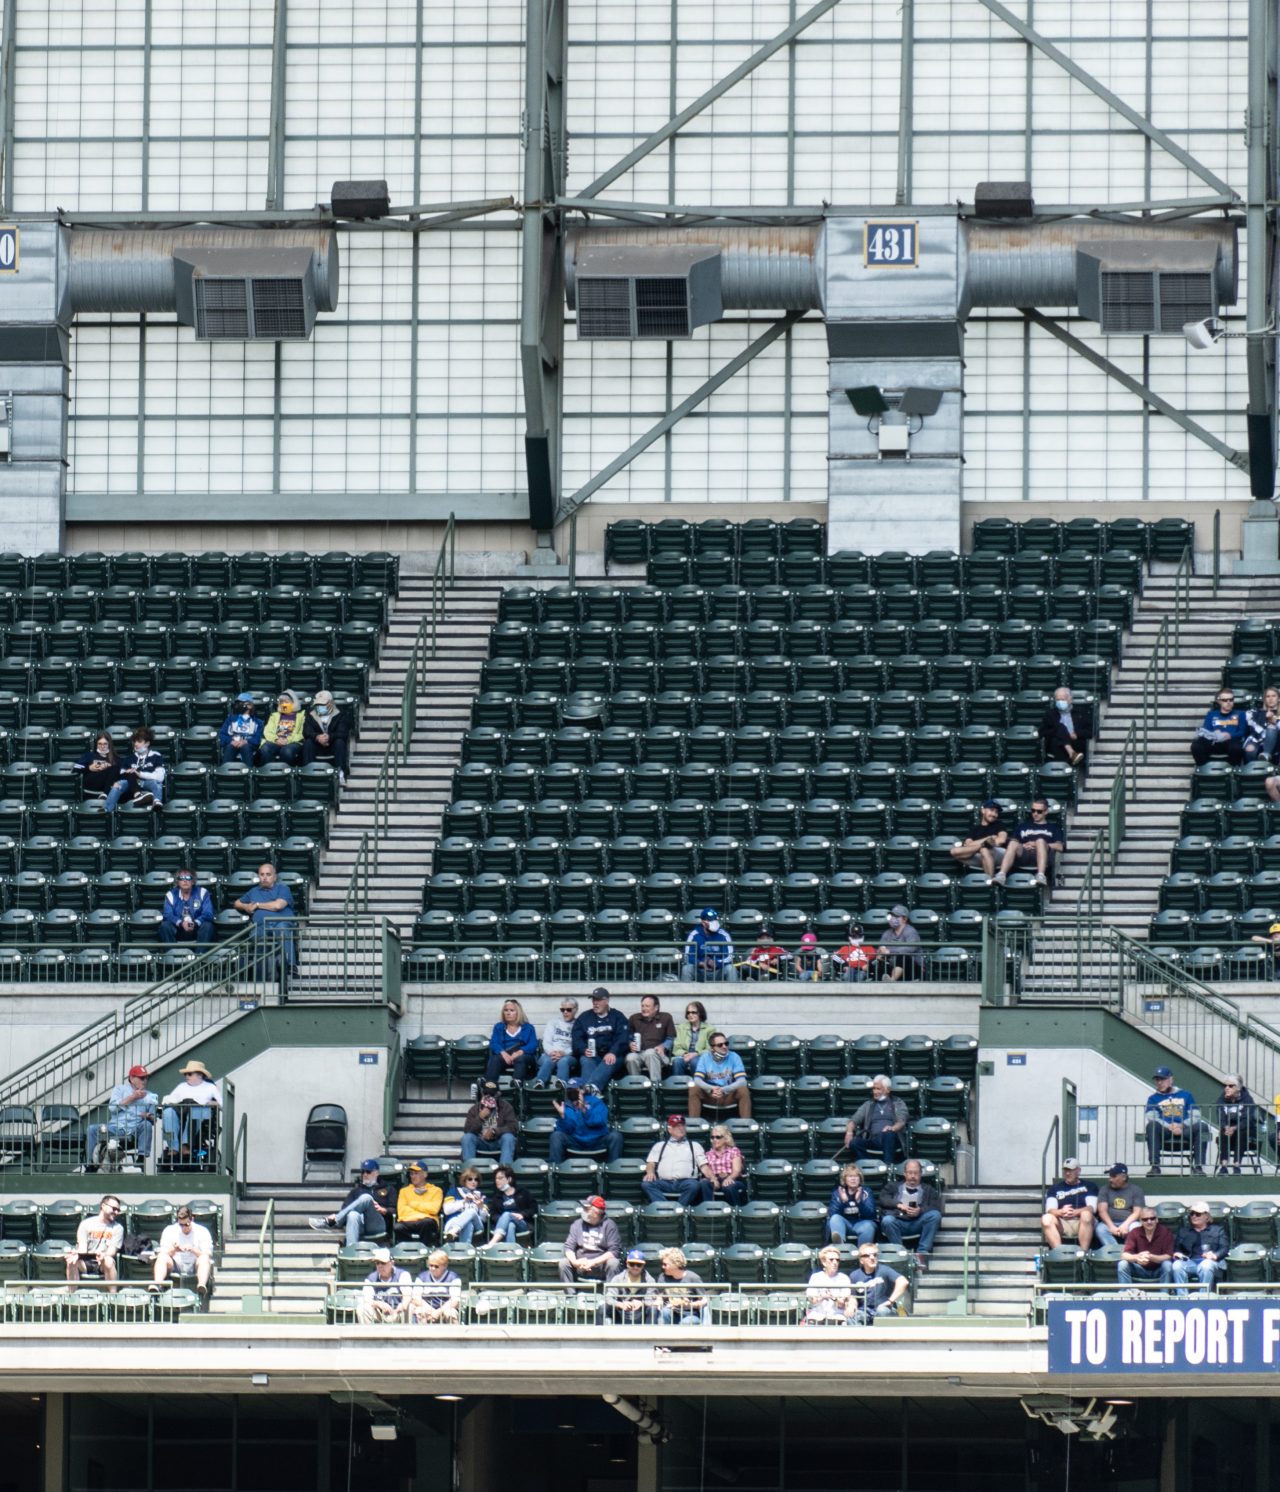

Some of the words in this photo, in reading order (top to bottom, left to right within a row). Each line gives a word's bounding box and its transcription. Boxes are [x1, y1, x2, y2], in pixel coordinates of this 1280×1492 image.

[869, 228, 913, 261] 431
[1065, 1308, 1107, 1364] TO
[1122, 1308, 1250, 1364] REPORT
[1263, 1308, 1280, 1364] F
